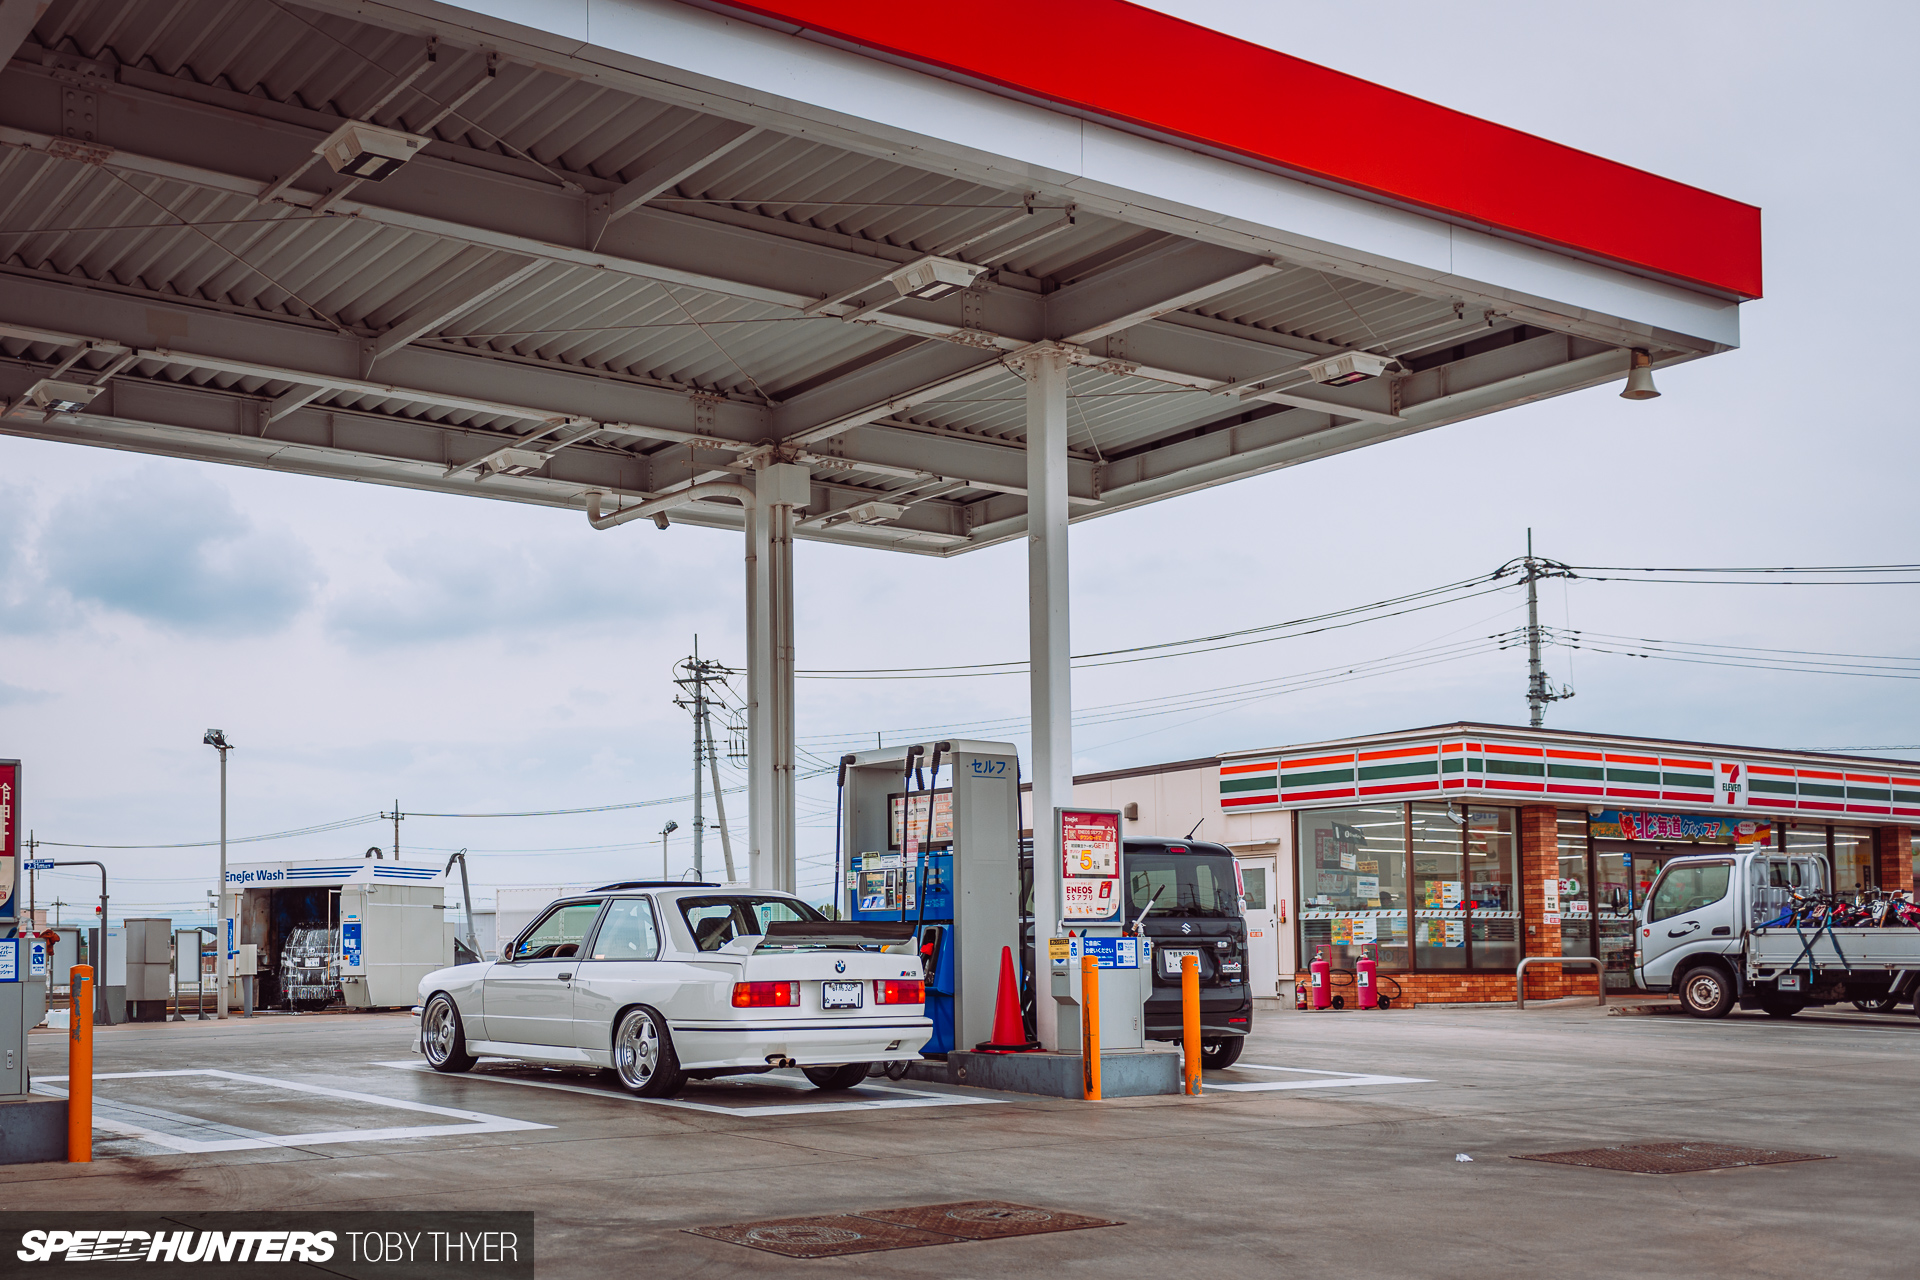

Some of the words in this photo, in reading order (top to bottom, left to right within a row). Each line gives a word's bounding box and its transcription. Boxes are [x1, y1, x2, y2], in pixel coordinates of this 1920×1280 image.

[971, 759, 1006, 774] セルフ
[1080, 849, 1093, 870] 5
[256, 870, 284, 881] Wash
[1066, 886, 1093, 894] ENEOS
